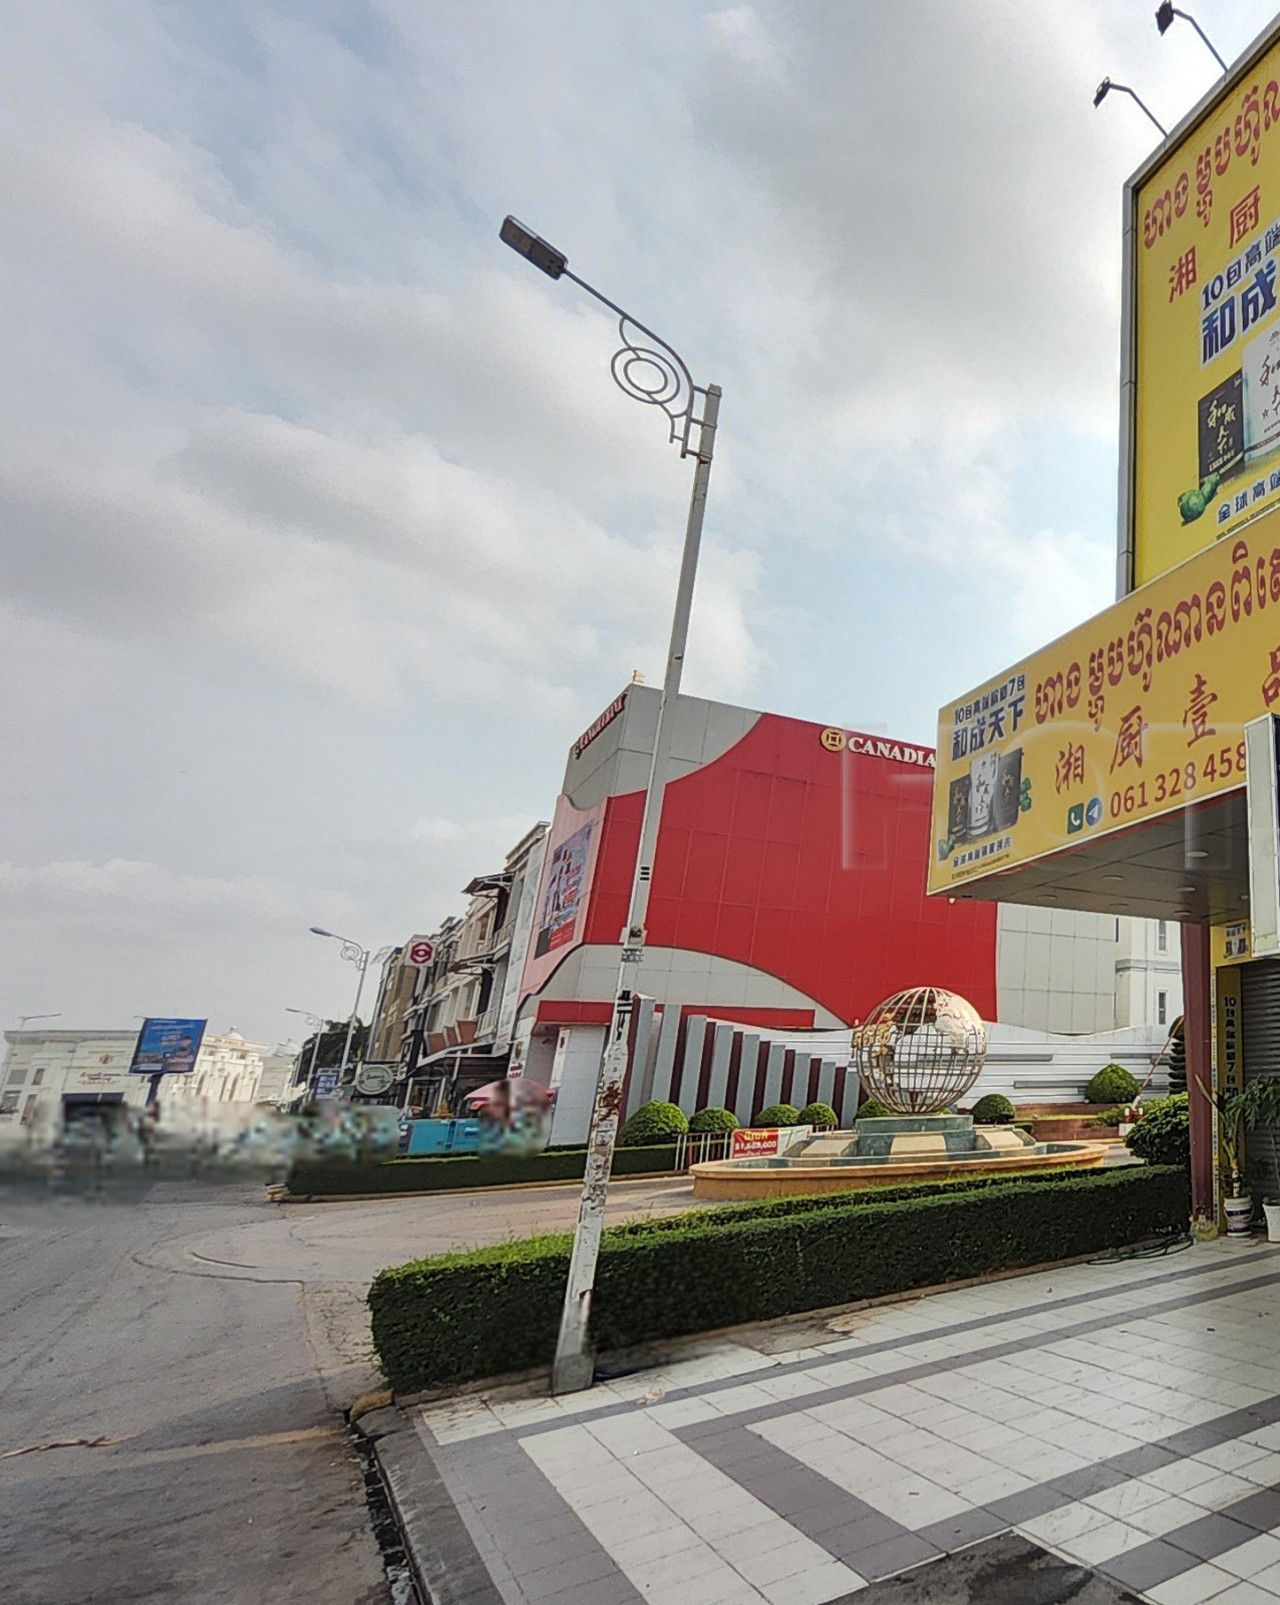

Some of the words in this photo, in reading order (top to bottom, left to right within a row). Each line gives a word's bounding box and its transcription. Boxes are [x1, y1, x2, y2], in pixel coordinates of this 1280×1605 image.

[1110, 781, 1149, 818] 061
[1155, 761, 1197, 802] 328
[1203, 740, 1247, 783] 458
